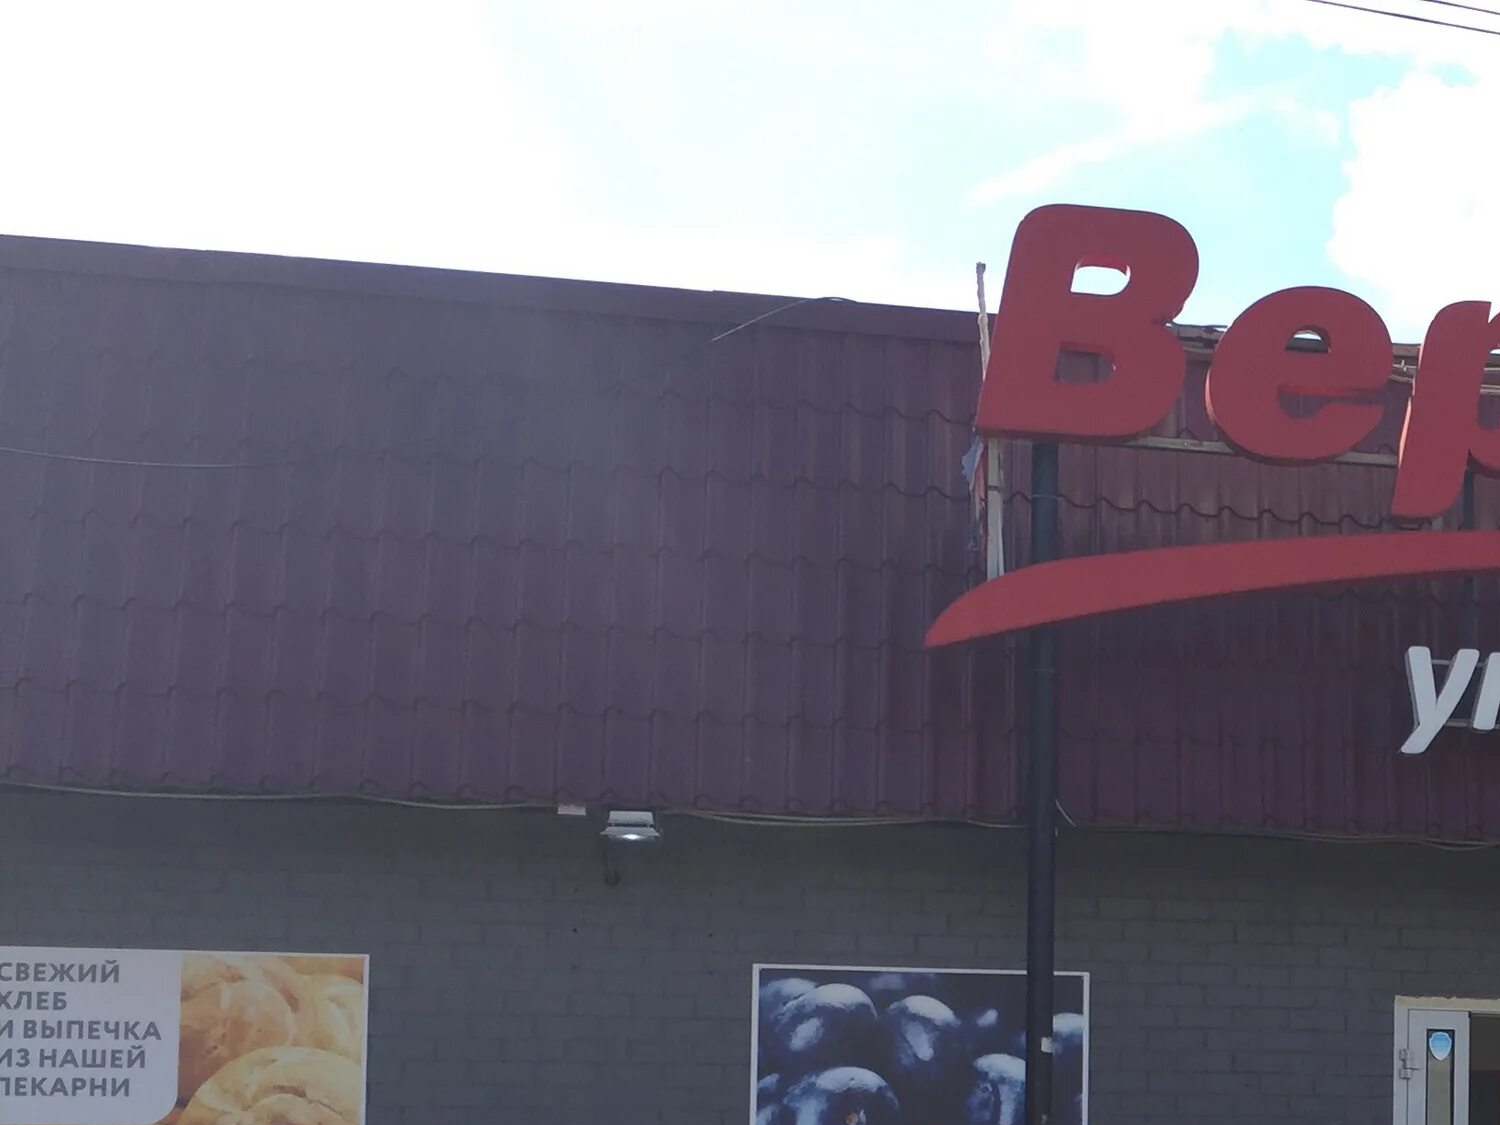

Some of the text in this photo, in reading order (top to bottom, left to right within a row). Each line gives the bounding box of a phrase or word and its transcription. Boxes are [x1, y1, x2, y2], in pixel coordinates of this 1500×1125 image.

[0, 960, 120, 983] СВЕЖИЙ
[0, 990, 67, 1011] ХЛЕБ
[23, 1019, 162, 1041] ВЫПЕЧКА
[38, 1044, 146, 1069] НАШЕЙ
[0, 1076, 130, 1097] ПЕКАРНИ
